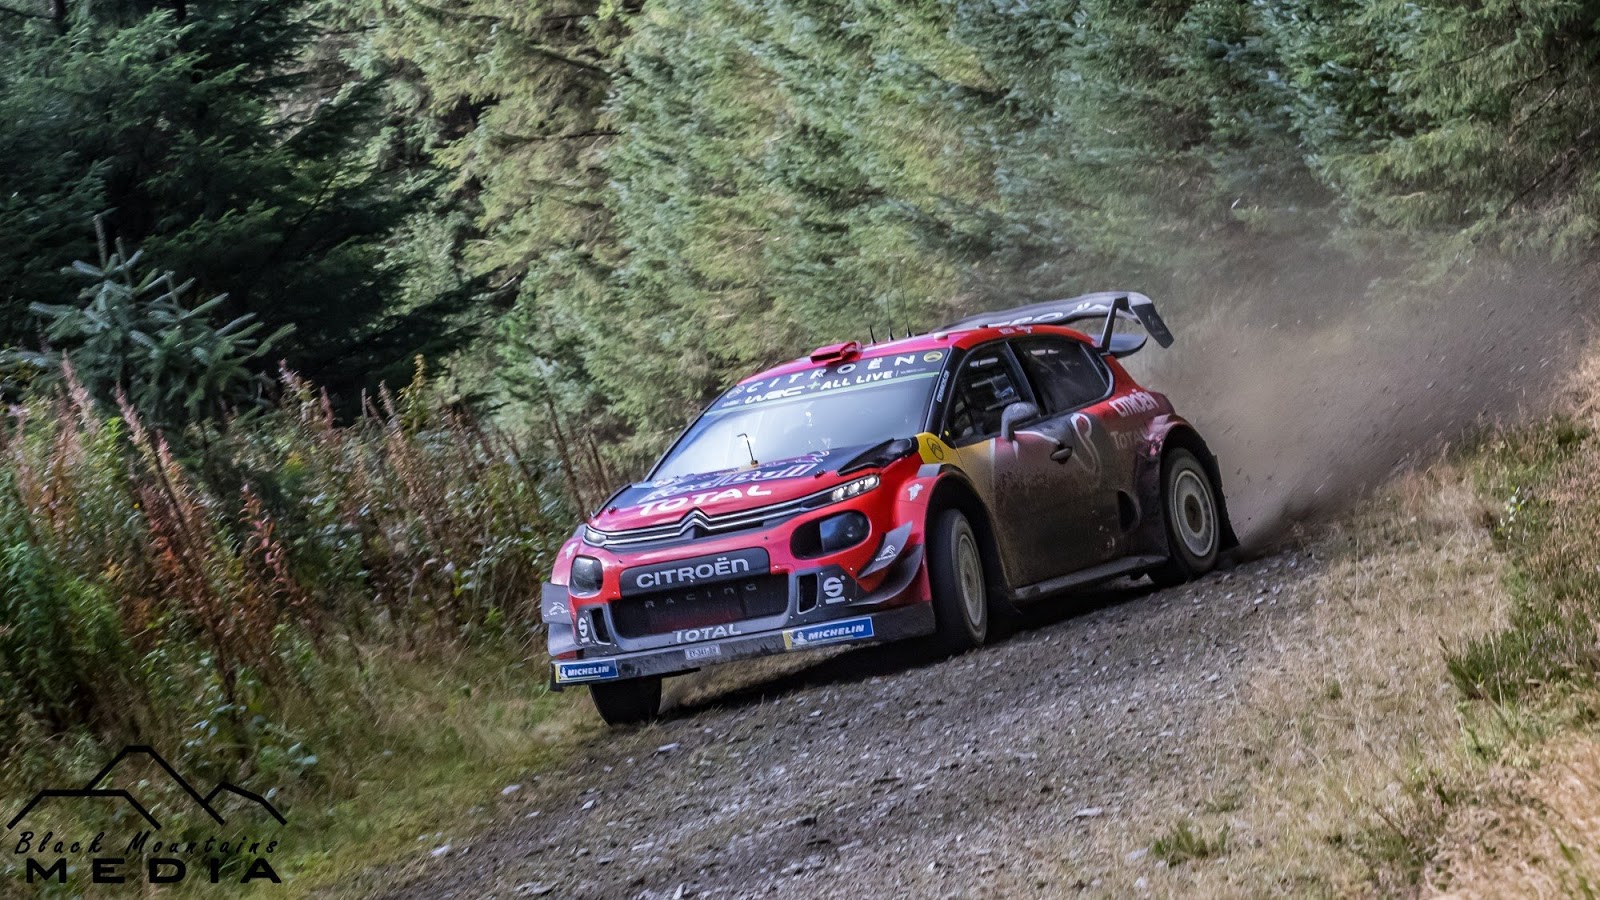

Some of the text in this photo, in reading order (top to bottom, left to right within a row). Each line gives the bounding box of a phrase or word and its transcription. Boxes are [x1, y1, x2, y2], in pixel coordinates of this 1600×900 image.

[820, 377, 851, 391] ALL
[856, 370, 893, 384] LIVE
[639, 484, 772, 517] TOTAL
[672, 623, 742, 643] TOTAL
[808, 624, 865, 641] MICHELIN
[567, 665, 610, 677] MICHELIN
